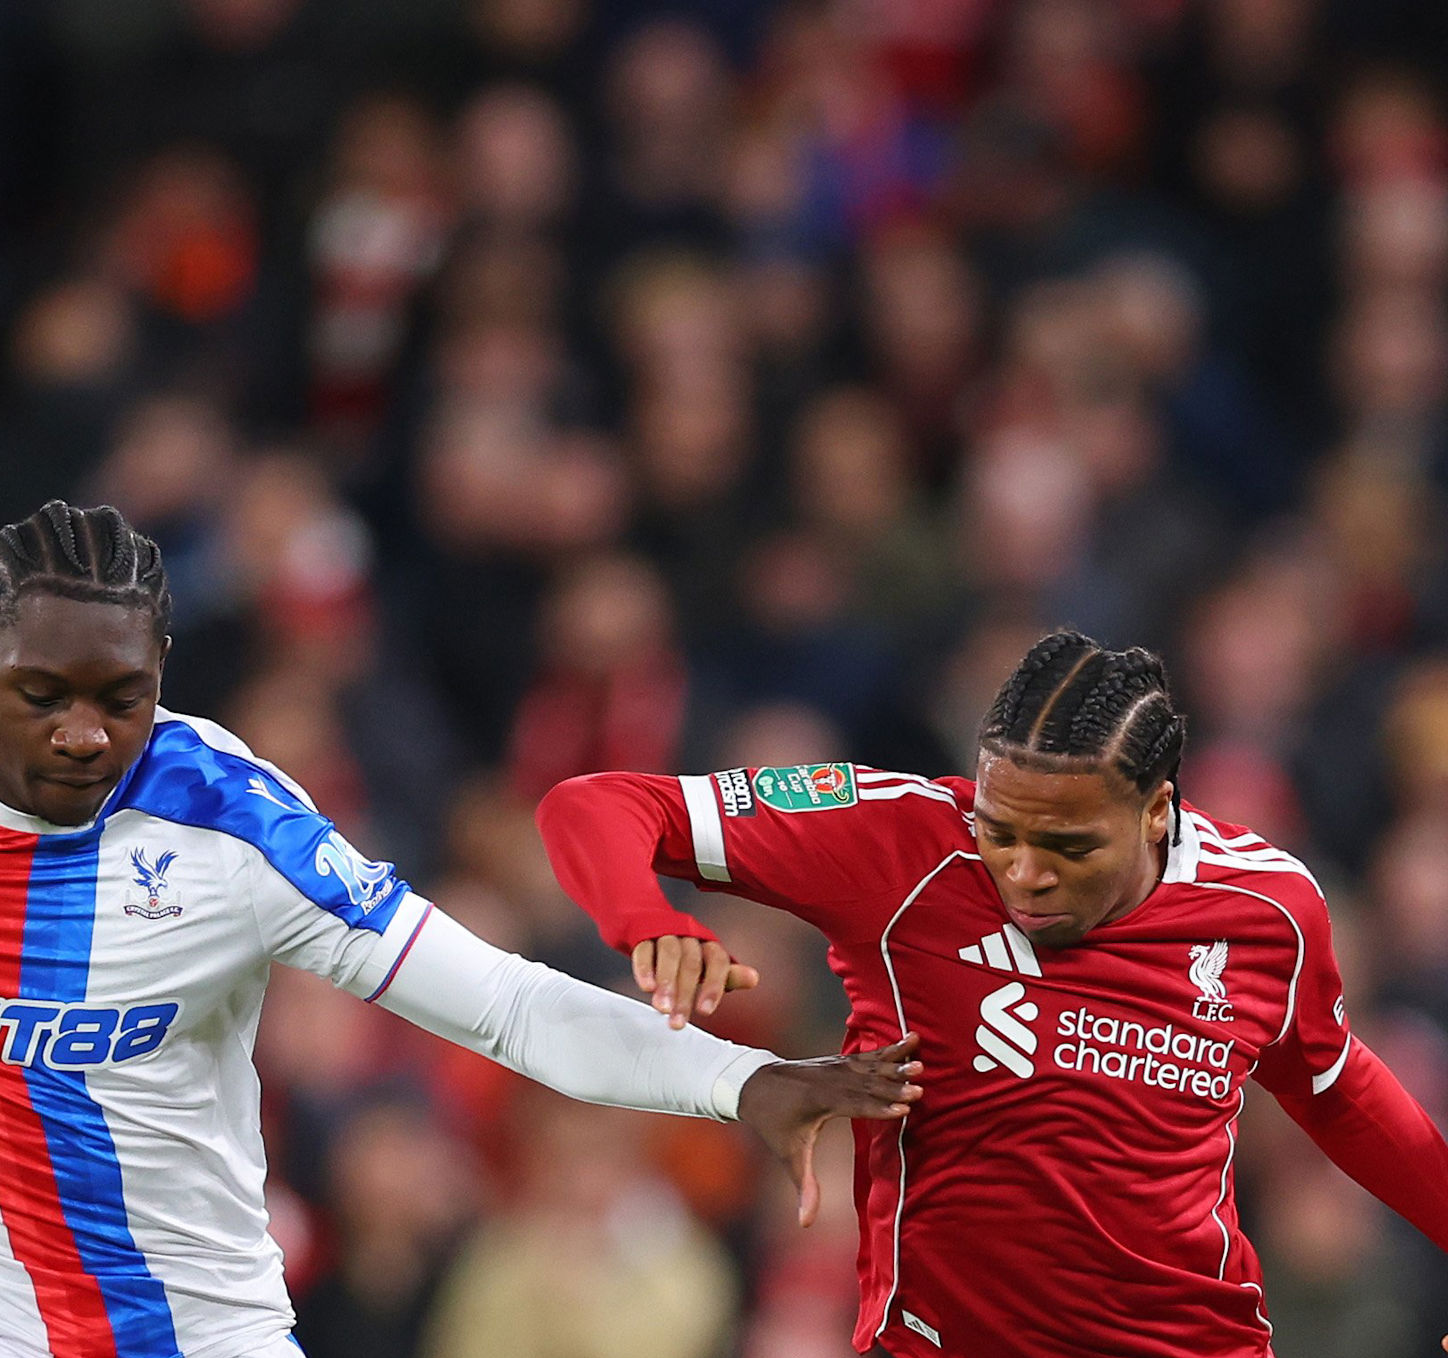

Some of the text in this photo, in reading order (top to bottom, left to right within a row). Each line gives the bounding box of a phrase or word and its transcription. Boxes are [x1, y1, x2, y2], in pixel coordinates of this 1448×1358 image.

[796, 765, 821, 804] arabao
[1192, 1001, 1234, 1022] L.F.C.
[1056, 1006, 1236, 1069] standard
[1053, 1039, 1233, 1099] chartered
